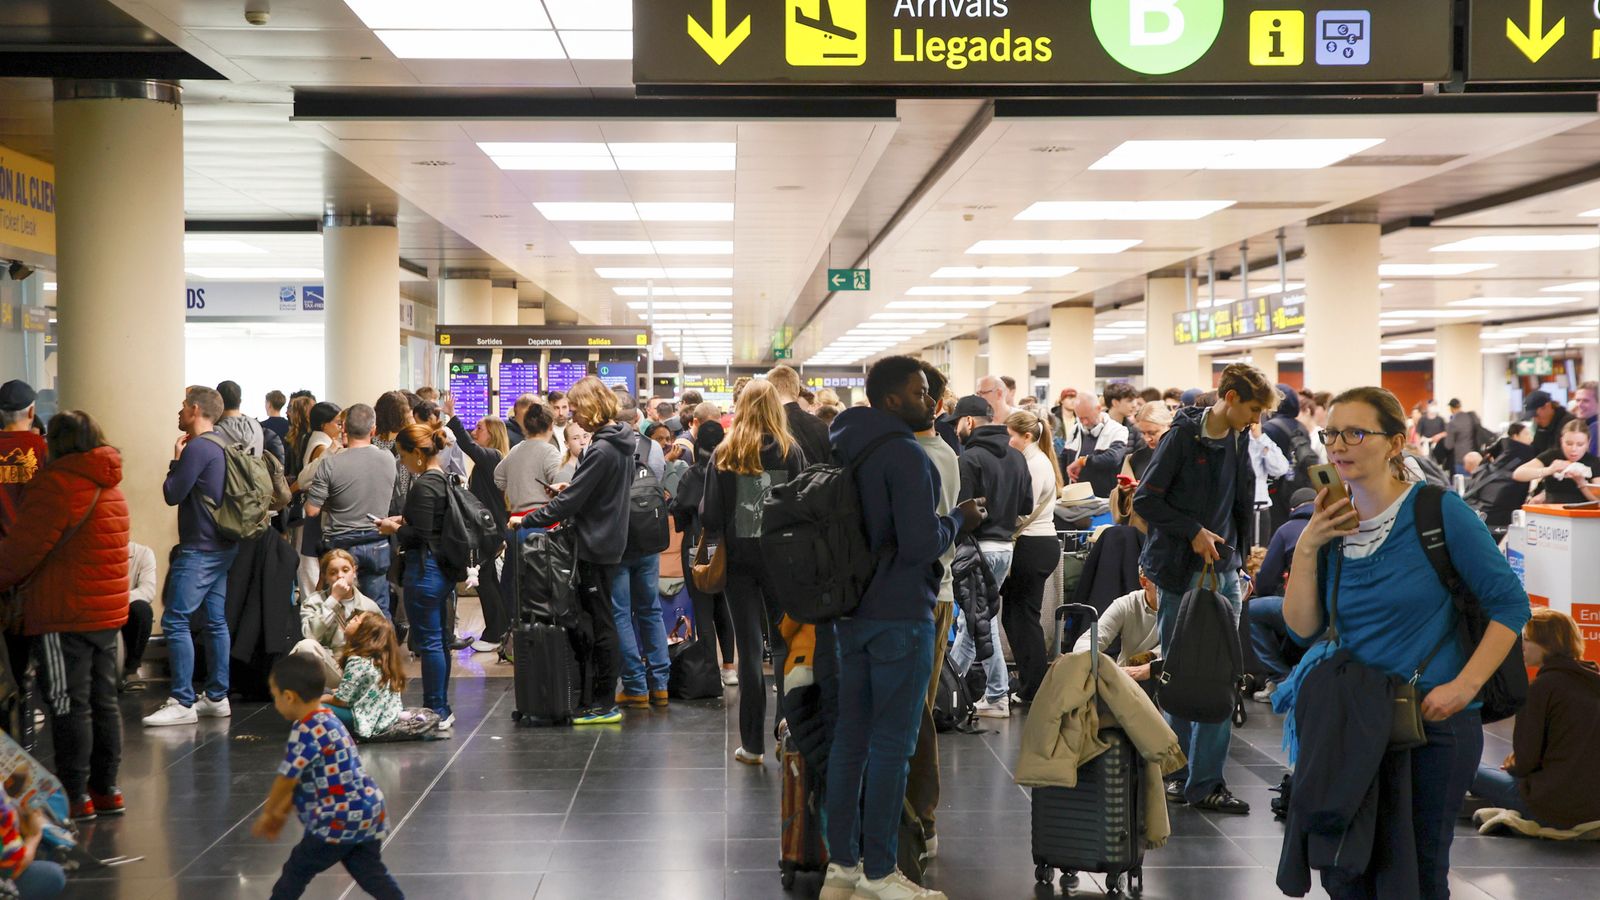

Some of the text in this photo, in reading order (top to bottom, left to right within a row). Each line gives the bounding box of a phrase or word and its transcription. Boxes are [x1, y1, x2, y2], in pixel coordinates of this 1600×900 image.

[893, 0, 1009, 18] Arrivals
[1129, 0, 1185, 46] B
[893, 28, 1053, 70] Llegadas
[16, 171, 28, 207] AL
[21, 213, 37, 236] Desk
[186, 288, 205, 309] DS
[476, 338, 611, 347] Sortides Departures Salidas
[1538, 525, 1569, 542] BAG WRAP
